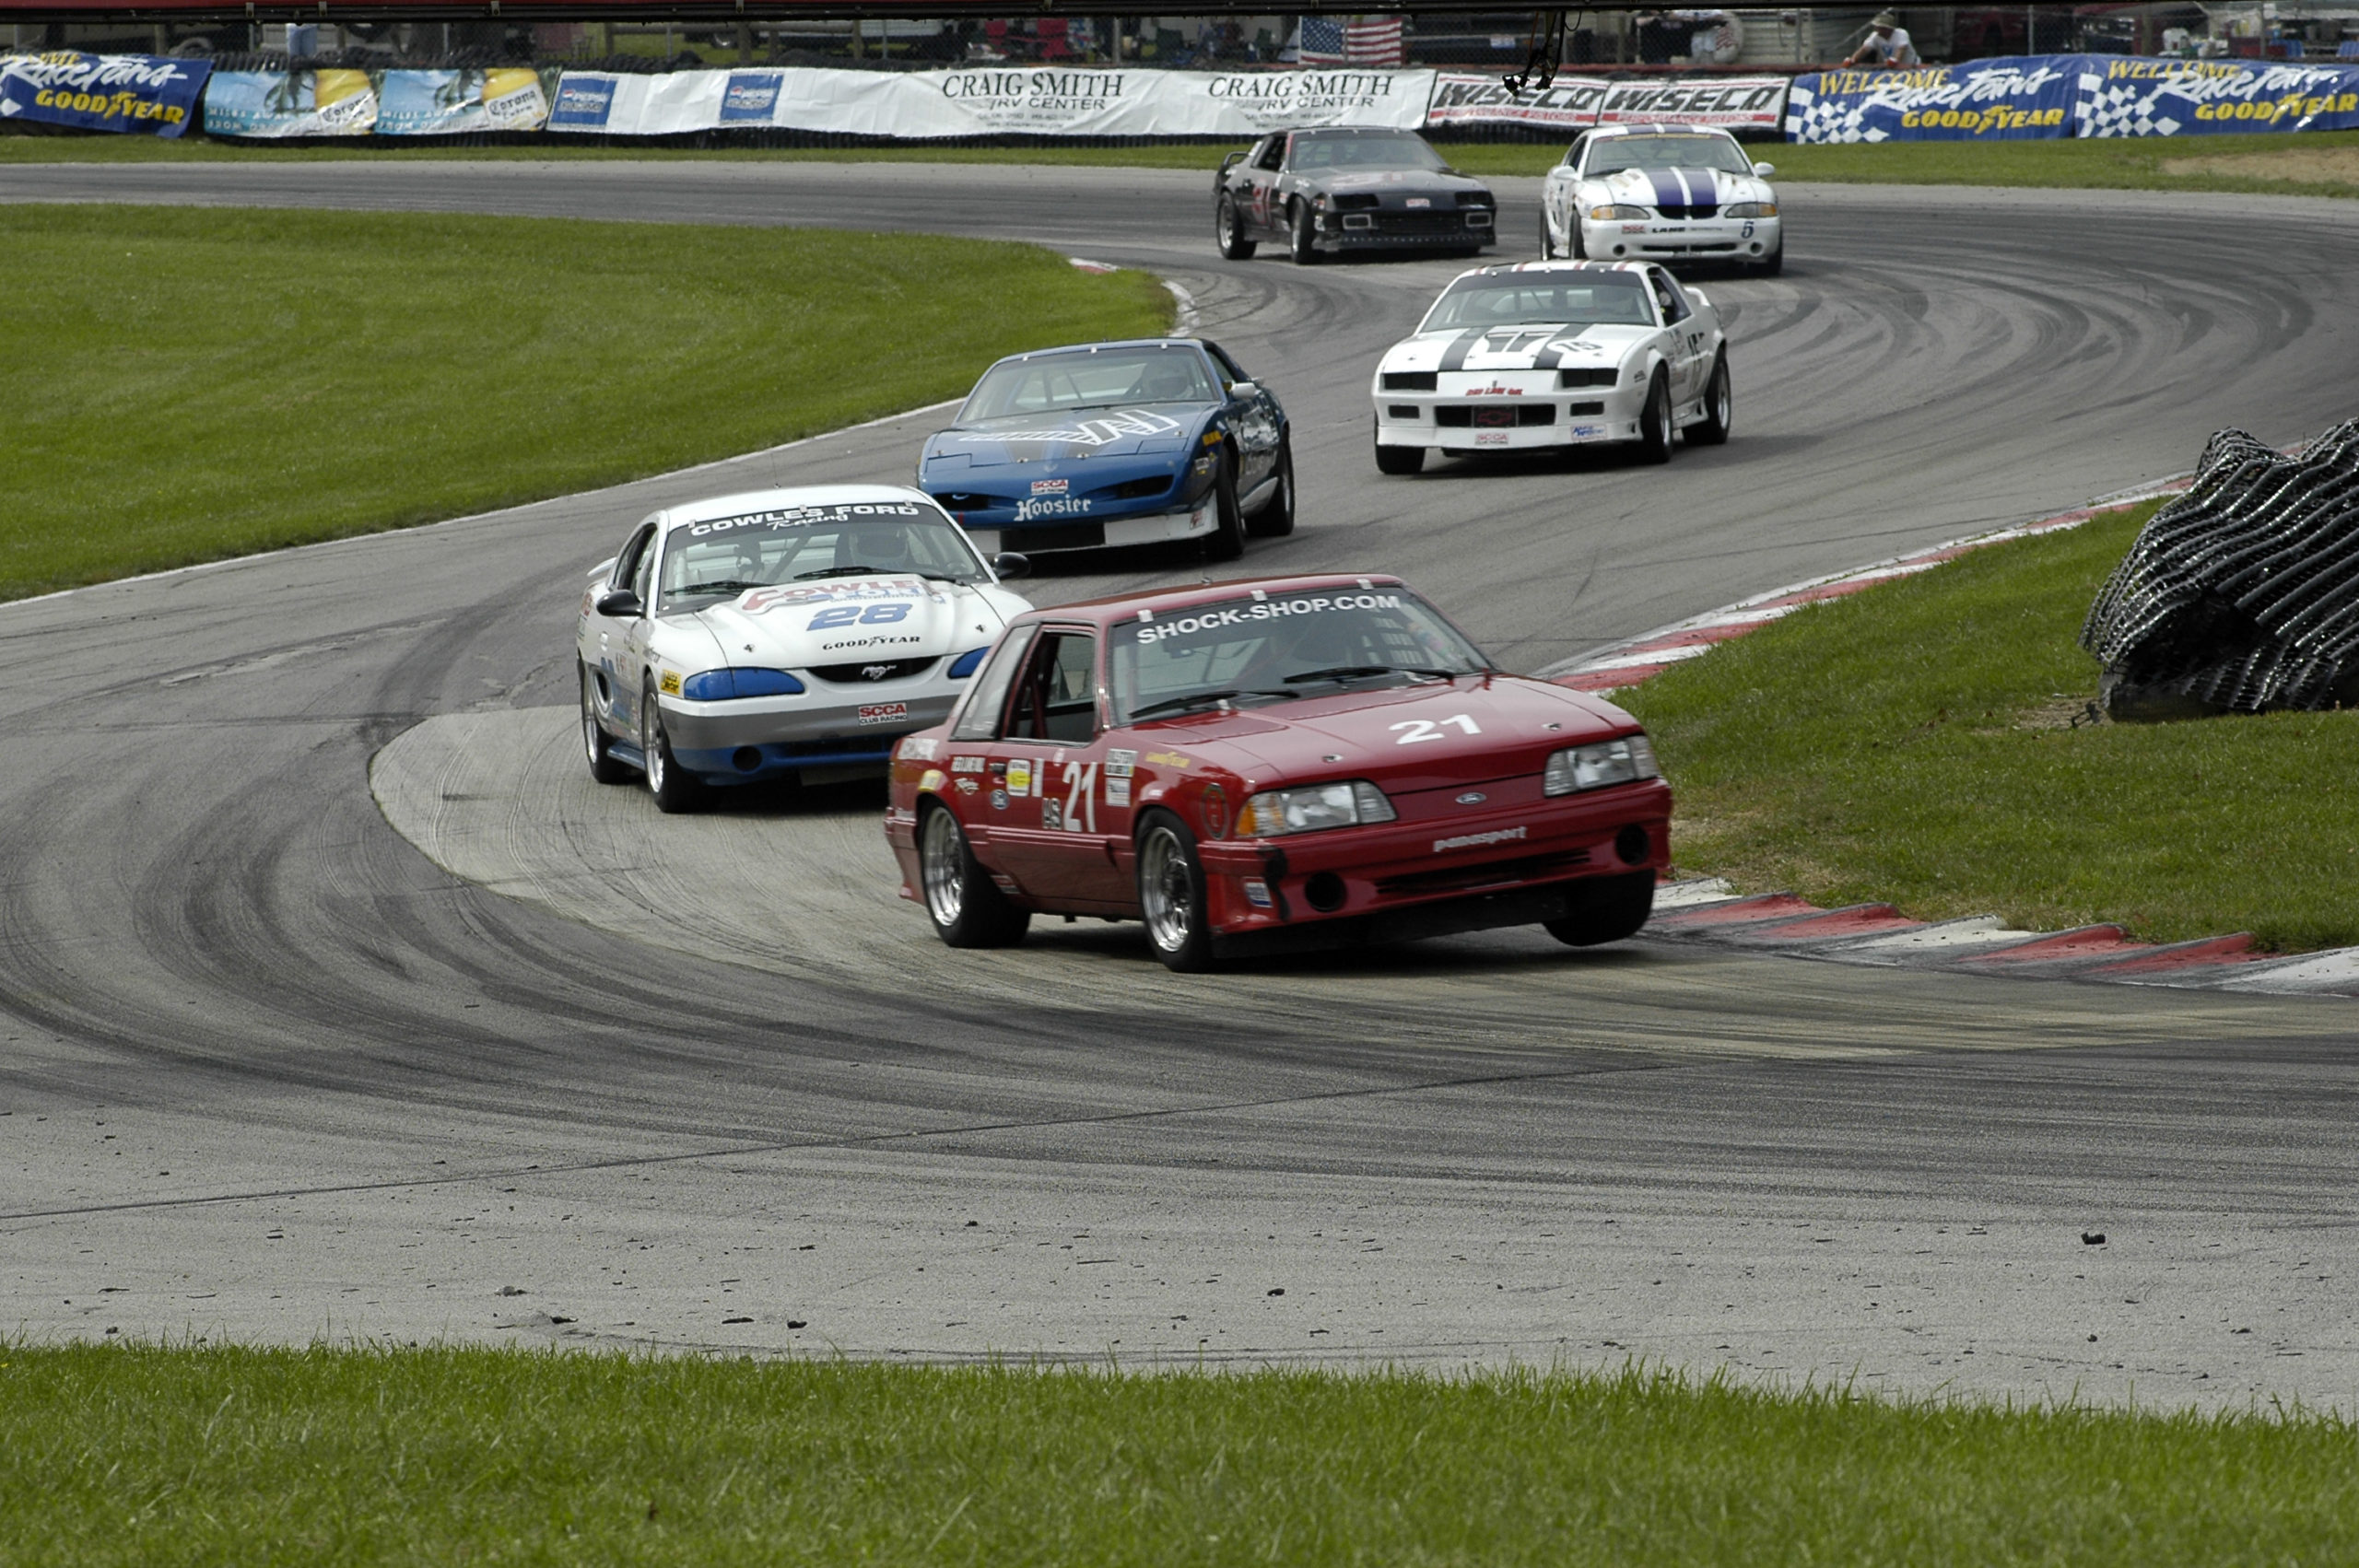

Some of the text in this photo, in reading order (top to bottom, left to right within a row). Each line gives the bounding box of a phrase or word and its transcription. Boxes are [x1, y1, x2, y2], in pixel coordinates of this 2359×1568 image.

[942, 72, 1124, 98] CRAIG SMITH
[1209, 74, 1394, 98] CRAIG SMITH
[1819, 69, 1953, 96] WELCOME
[35, 89, 184, 124] GOODYEAR
[488, 89, 537, 116] Corona
[1028, 98, 1107, 111] CENTER
[1297, 97, 1375, 108] CENTER
[1433, 82, 1604, 111] WISECO
[1604, 86, 1783, 111] WISECO
[2195, 93, 2359, 125] GOODYEAR
[1901, 104, 2064, 134] GOODYEAR
[1741, 220, 1755, 240] 5
[1033, 480, 1067, 489] SCCA
[691, 505, 920, 536] COWLES FORD
[1014, 494, 1091, 521] Hoosier
[767, 512, 849, 531] Racing
[806, 603, 912, 631] 28
[1136, 595, 1401, 645] SHOCK-SHOP.COM
[823, 635, 921, 651] GOODYEAR
[859, 703, 907, 718] SCCA
[880, 714, 908, 722] RACING
[1388, 714, 1482, 744] 21
[1062, 760, 1098, 833] 21
